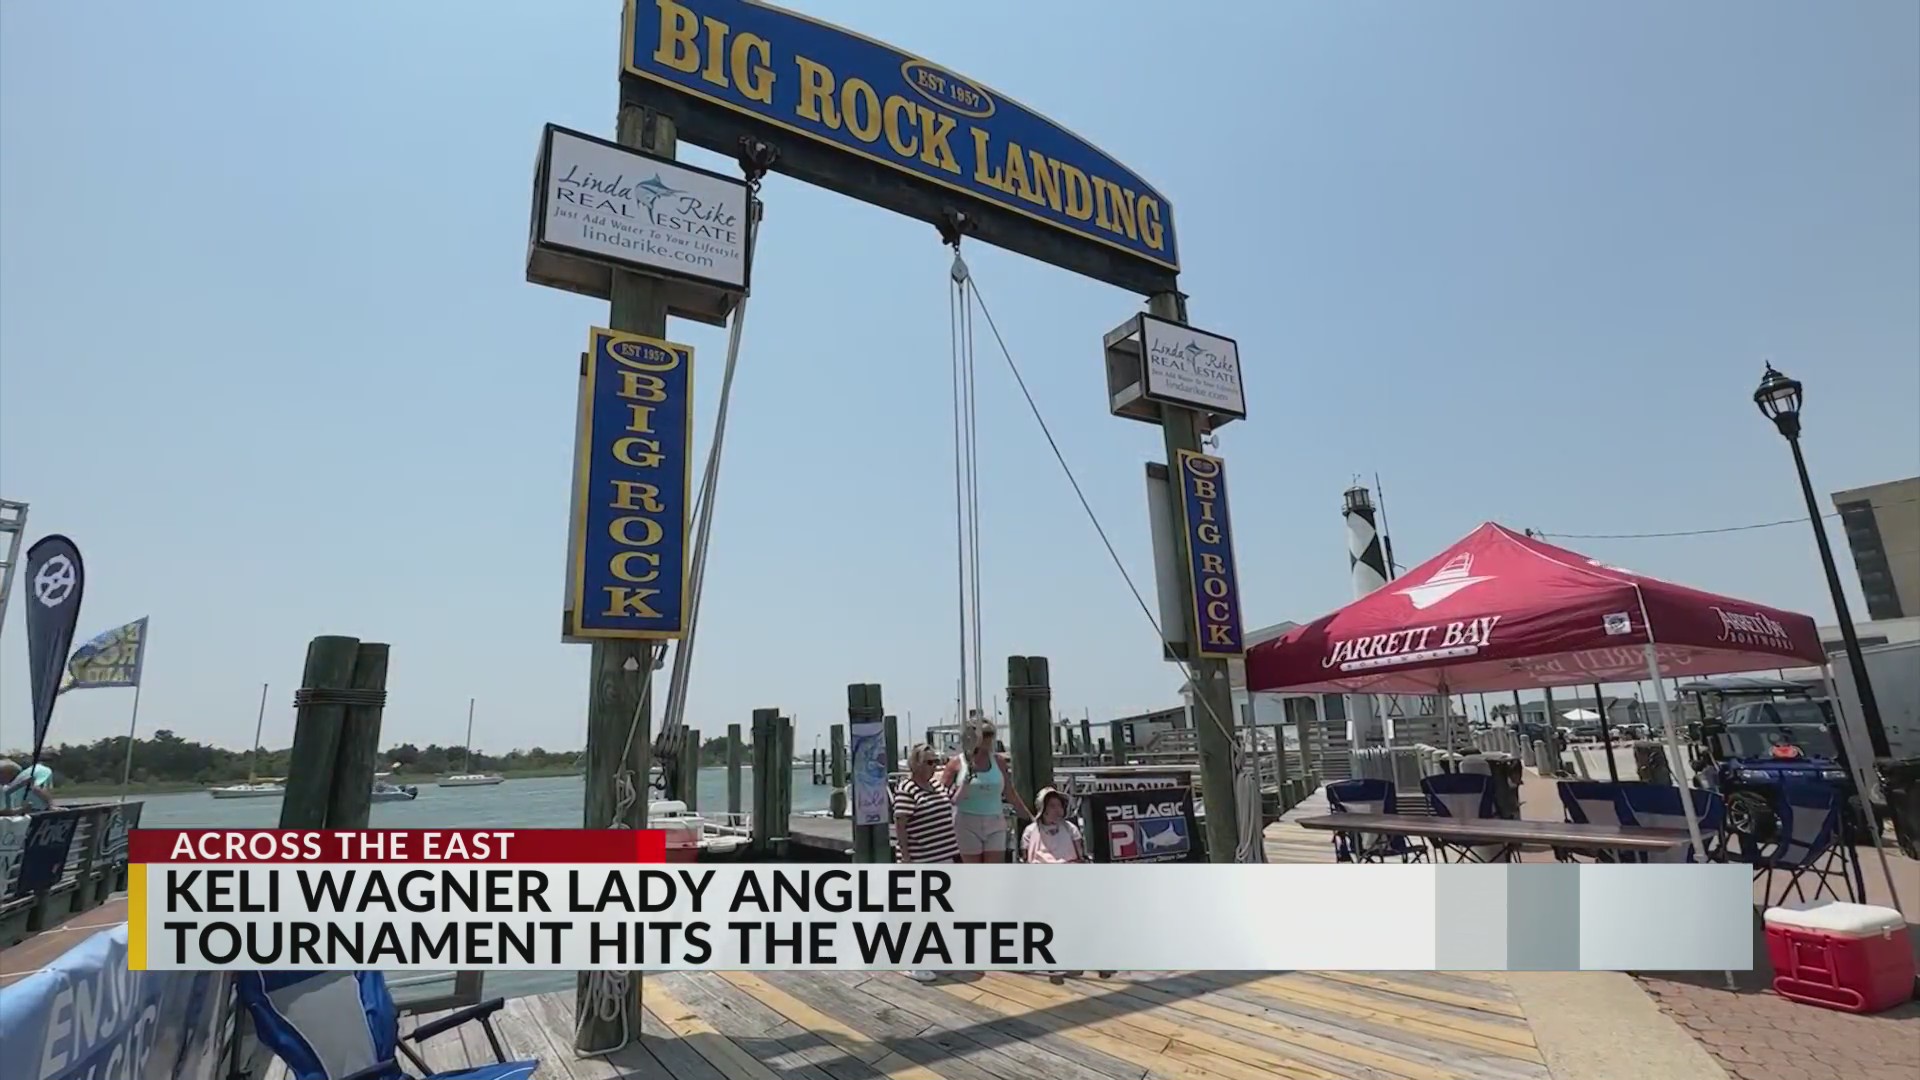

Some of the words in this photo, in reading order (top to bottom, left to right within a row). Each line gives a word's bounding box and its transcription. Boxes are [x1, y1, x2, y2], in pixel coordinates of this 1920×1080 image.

[917, 69, 946, 95] EST
[950, 84, 981, 109] 1957
[654, 0, 776, 104] BIG
[794, 54, 962, 175] ROCK
[970, 127, 1164, 251] LANDING
[557, 187, 636, 219] REAL
[657, 213, 737, 245] ESTATE
[558, 165, 633, 201] Linda
[676, 196, 737, 228] Rike
[554, 206, 578, 220] Just
[582, 212, 607, 227] Add
[611, 219, 644, 235] Water
[650, 226, 662, 239] To
[666, 234, 690, 247] Your
[694, 240, 740, 259] Lifestyle
[582, 225, 714, 268] lindarike.com
[621, 343, 642, 358] EST
[643, 345, 667, 362] 1957
[1151, 338, 1185, 359] Linda
[1151, 355, 1188, 372] REAL
[1197, 366, 1236, 384] ESTATE
[612, 370, 667, 468] BIG
[1193, 478, 1222, 544] BIG
[602, 480, 666, 618] ROCK
[1200, 553, 1234, 645] ROCK
[1322, 626, 1438, 669] JARRETT
[1441, 615, 1502, 648] BAY
[1105, 801, 1185, 820] PELAGIC
